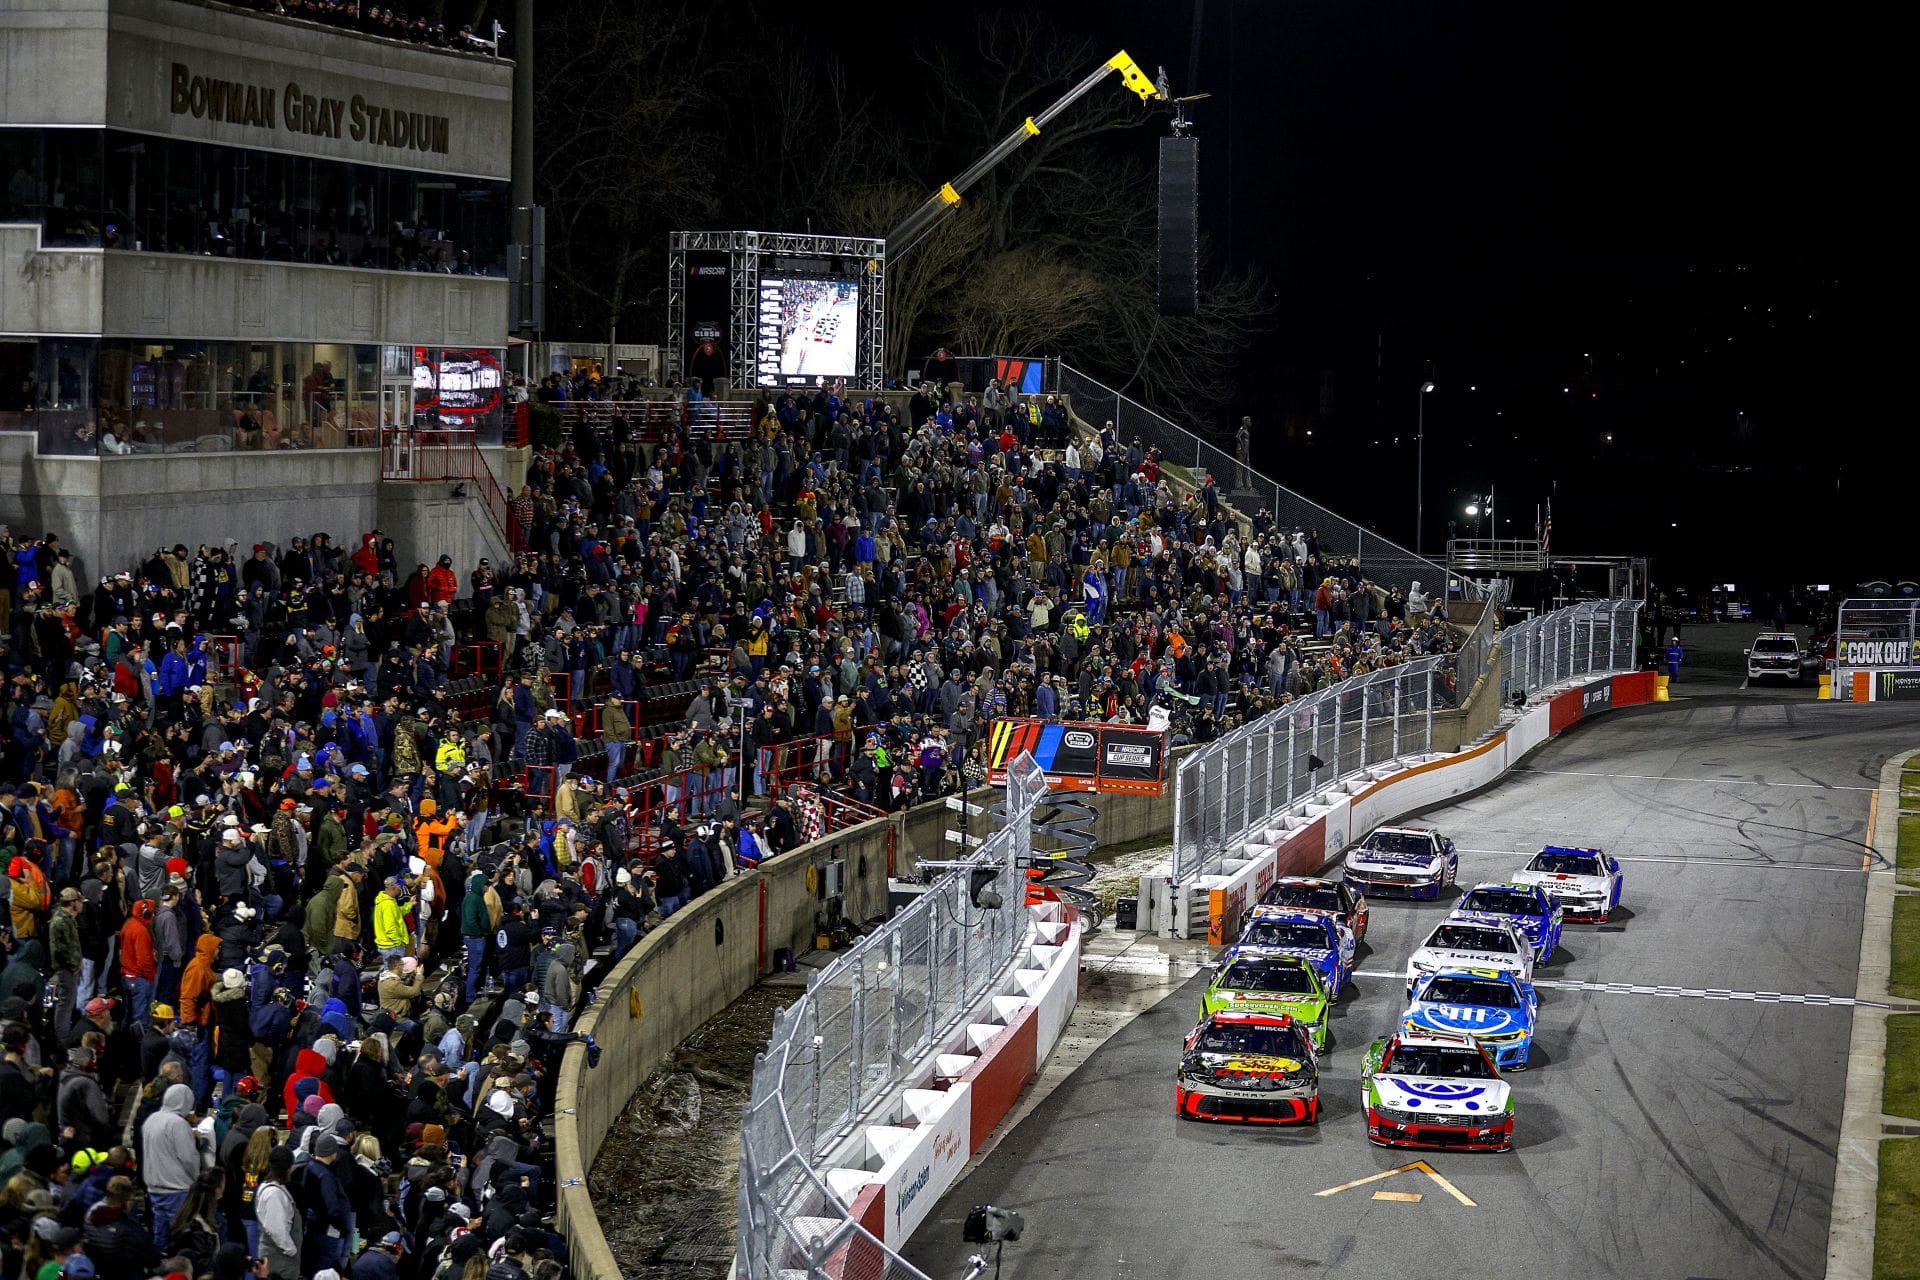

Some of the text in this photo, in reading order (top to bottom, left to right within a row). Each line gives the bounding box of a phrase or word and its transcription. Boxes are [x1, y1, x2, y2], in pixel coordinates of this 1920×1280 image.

[171, 62, 449, 154] BOWMAN GRAY STADIUM
[1847, 641, 1909, 664] COOK OUT
[1450, 952, 1514, 965] leidos
